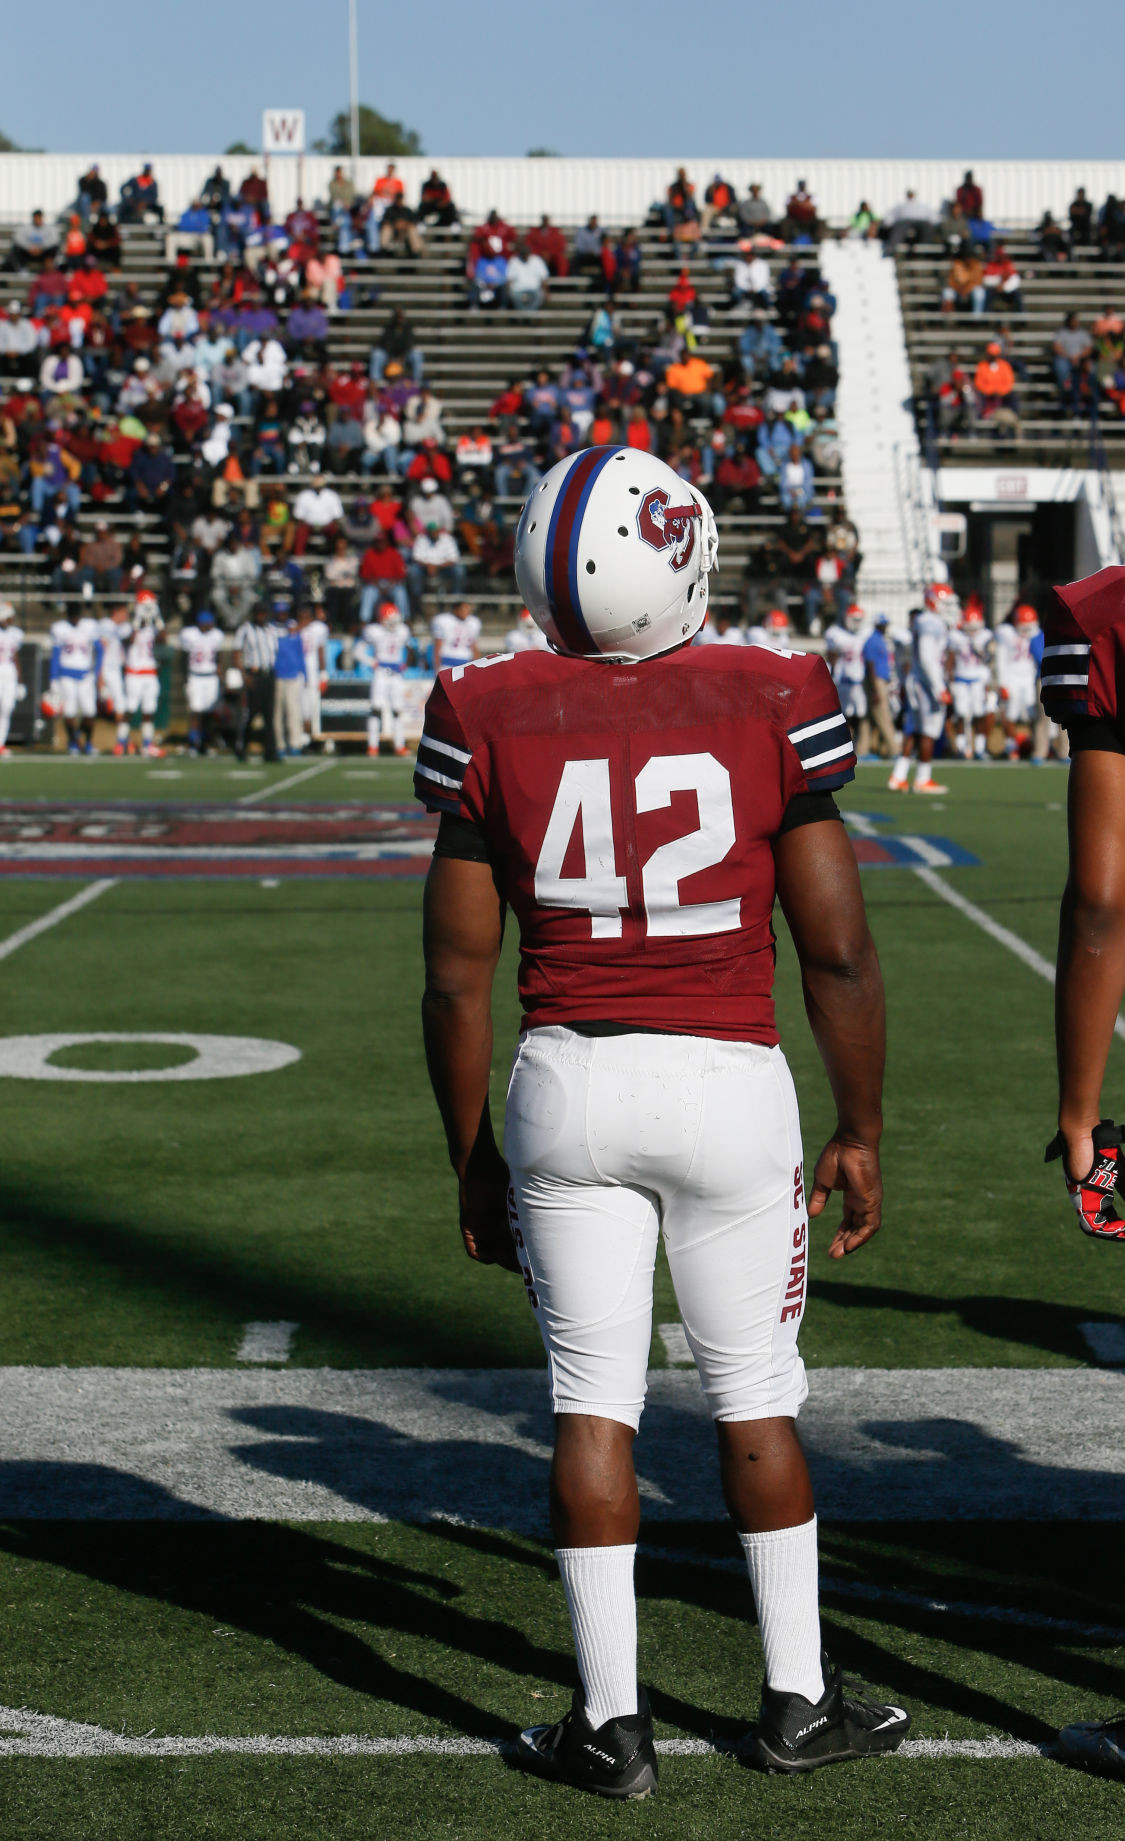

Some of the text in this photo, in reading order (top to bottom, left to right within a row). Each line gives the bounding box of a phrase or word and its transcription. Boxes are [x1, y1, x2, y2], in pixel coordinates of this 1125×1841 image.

[268, 117, 299, 142] W
[534, 752, 742, 938] 42
[780, 1161, 806, 1323] SC STATE
[795, 1715, 828, 1740] ALPHA
[583, 1744, 616, 1765] ALPHA
